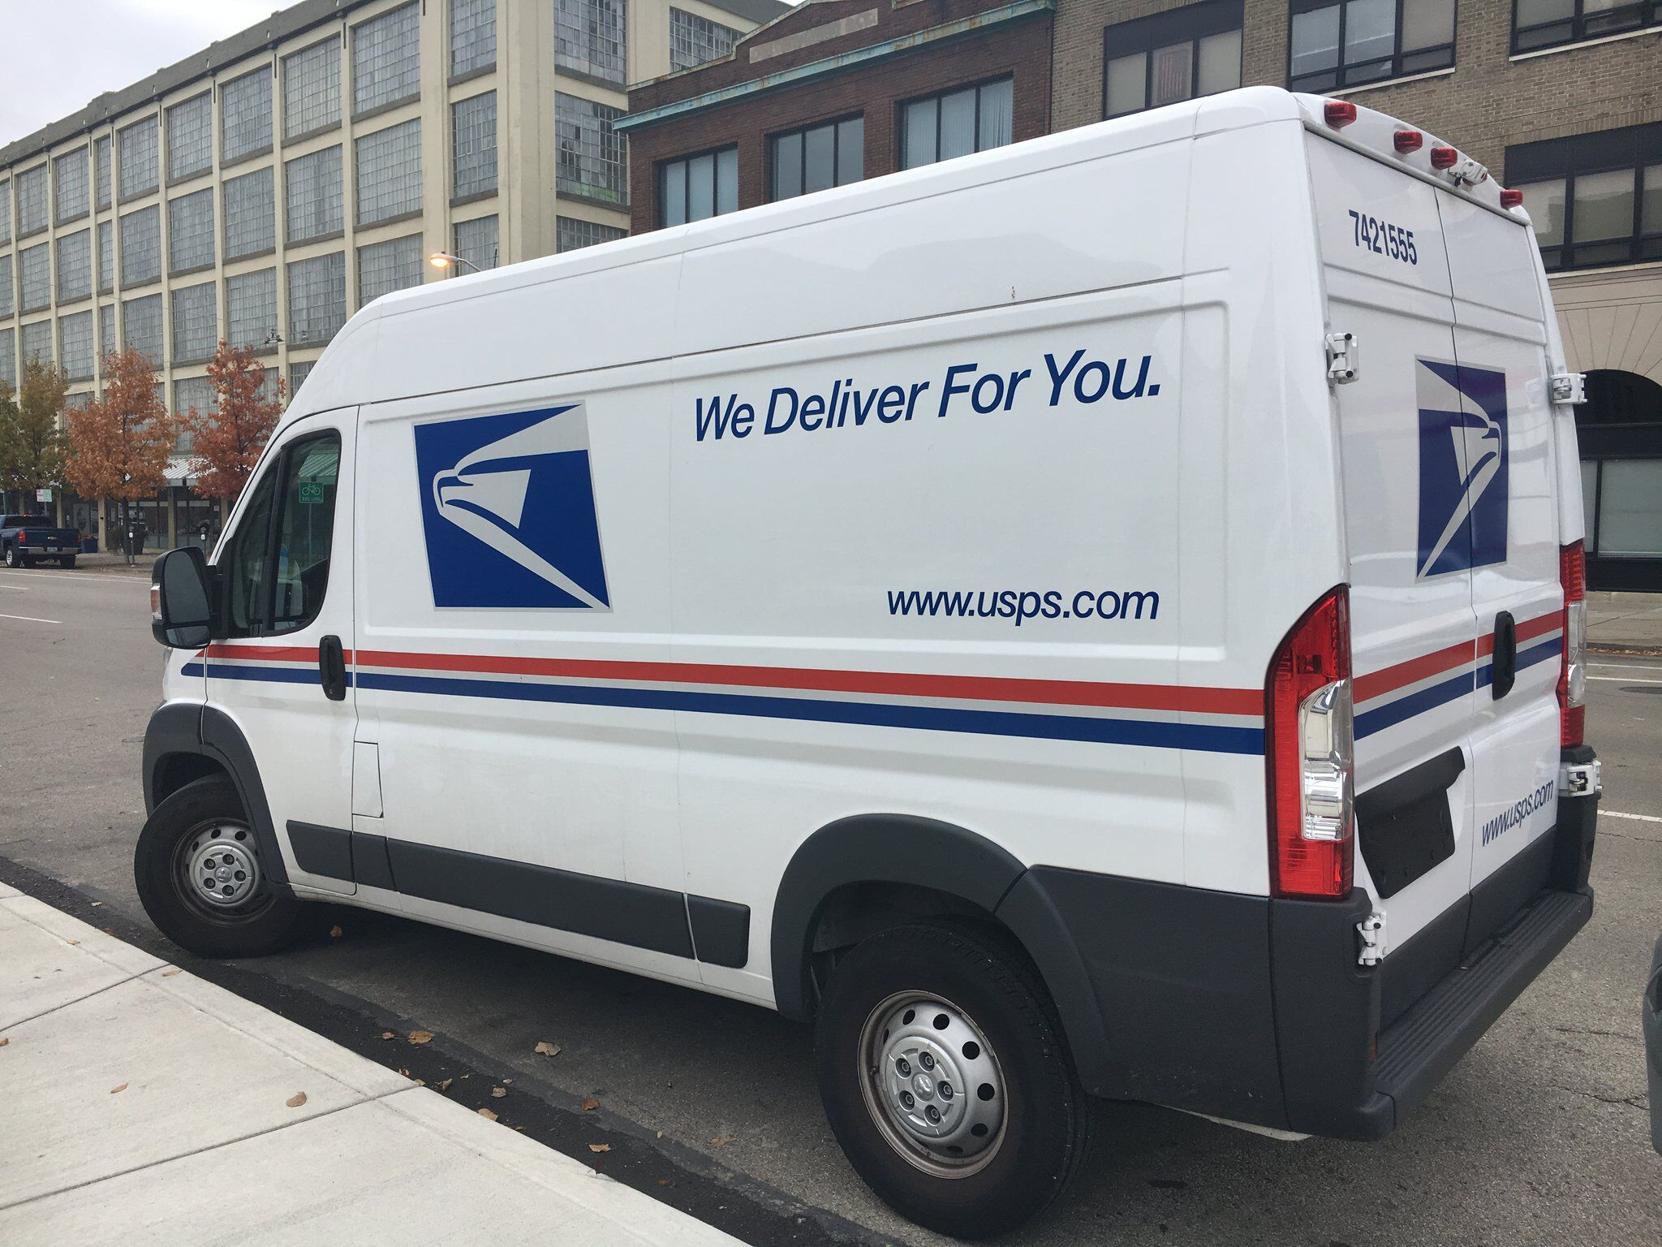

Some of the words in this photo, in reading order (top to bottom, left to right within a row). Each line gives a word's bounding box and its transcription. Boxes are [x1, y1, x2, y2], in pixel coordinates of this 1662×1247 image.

[1348, 209, 1418, 266] 7421555
[695, 393, 755, 442] We
[763, 378, 931, 436] Deliver
[937, 362, 1032, 418] For
[1043, 348, 1161, 407] You.
[887, 590, 1160, 627] www.usps.com
[1481, 779, 1554, 847] www.usps.com
